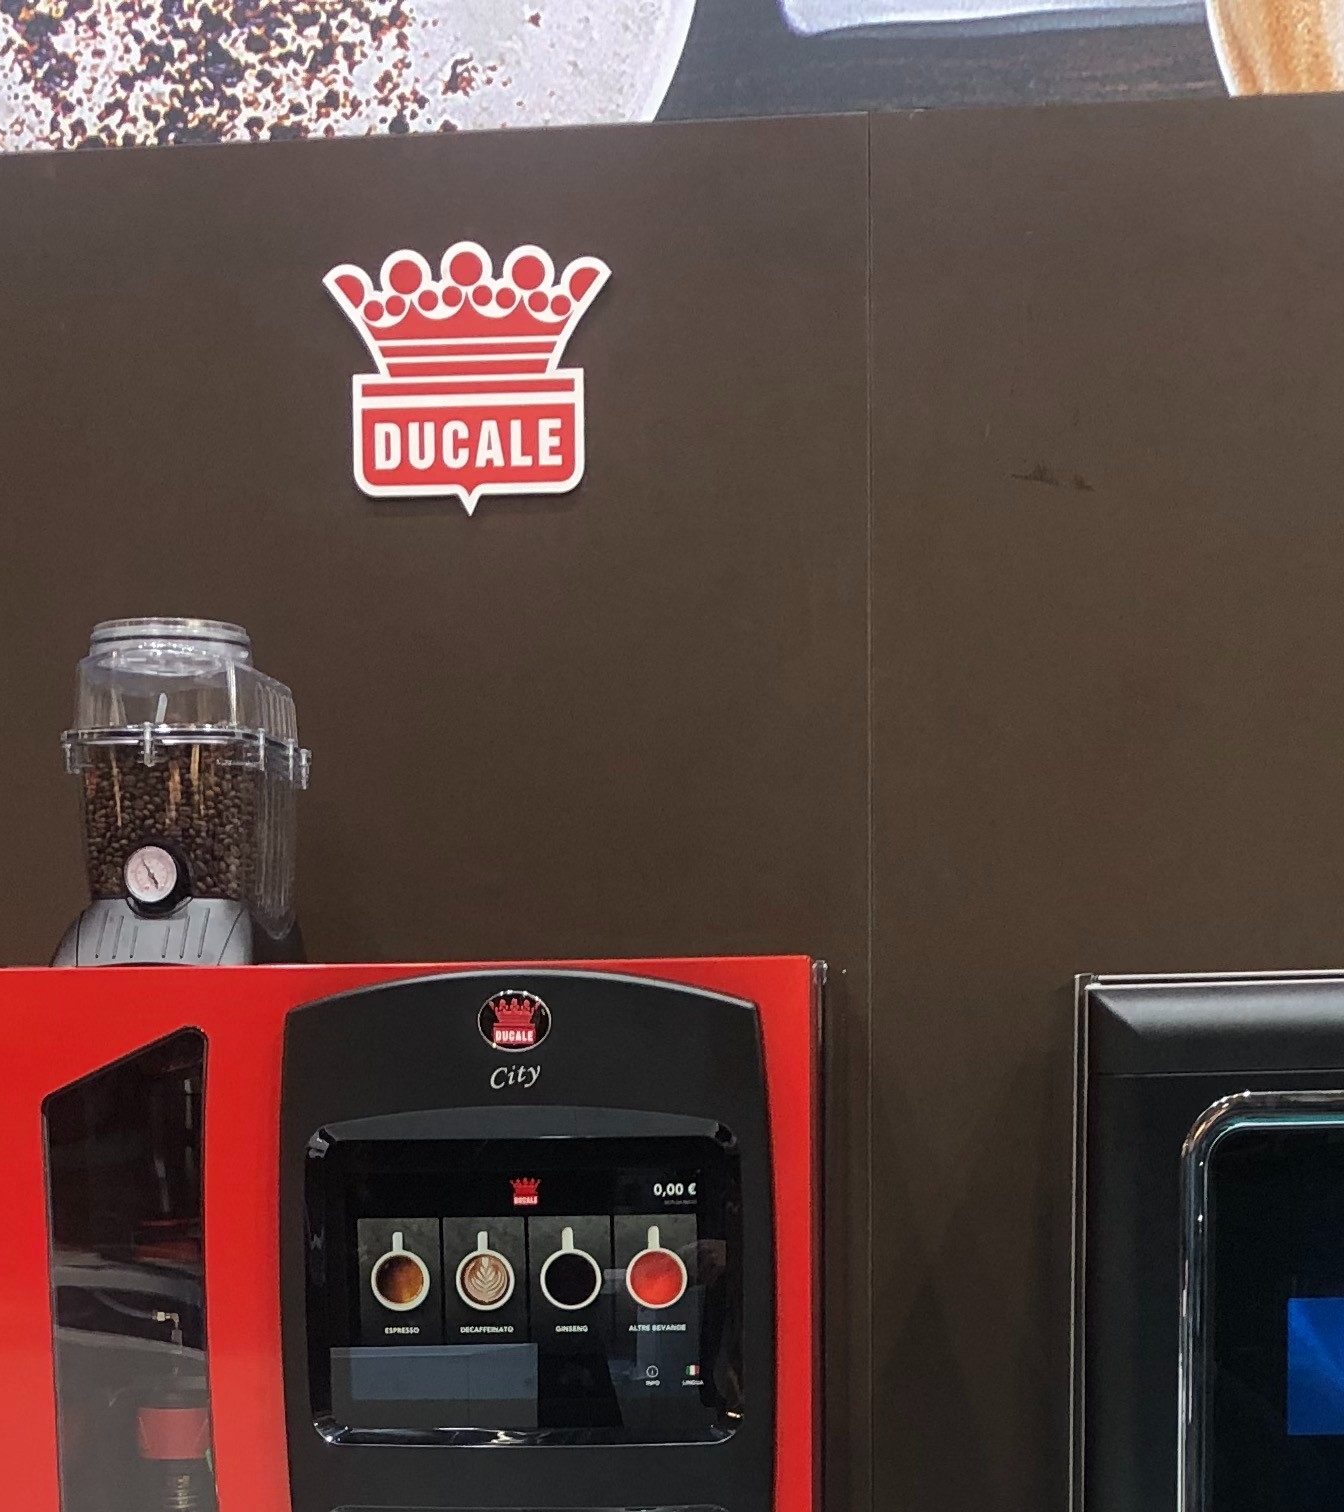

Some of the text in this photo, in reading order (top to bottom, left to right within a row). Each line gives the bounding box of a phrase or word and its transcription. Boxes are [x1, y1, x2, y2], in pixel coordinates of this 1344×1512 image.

[373, 417, 563, 471] DUCALE
[495, 1030, 534, 1042] DUCALE
[489, 1064, 541, 1090] City
[653, 1182, 697, 1198] 0,00 €
[384, 1326, 420, 1334] ESPRESSO
[555, 1324, 589, 1333] GINSENG
